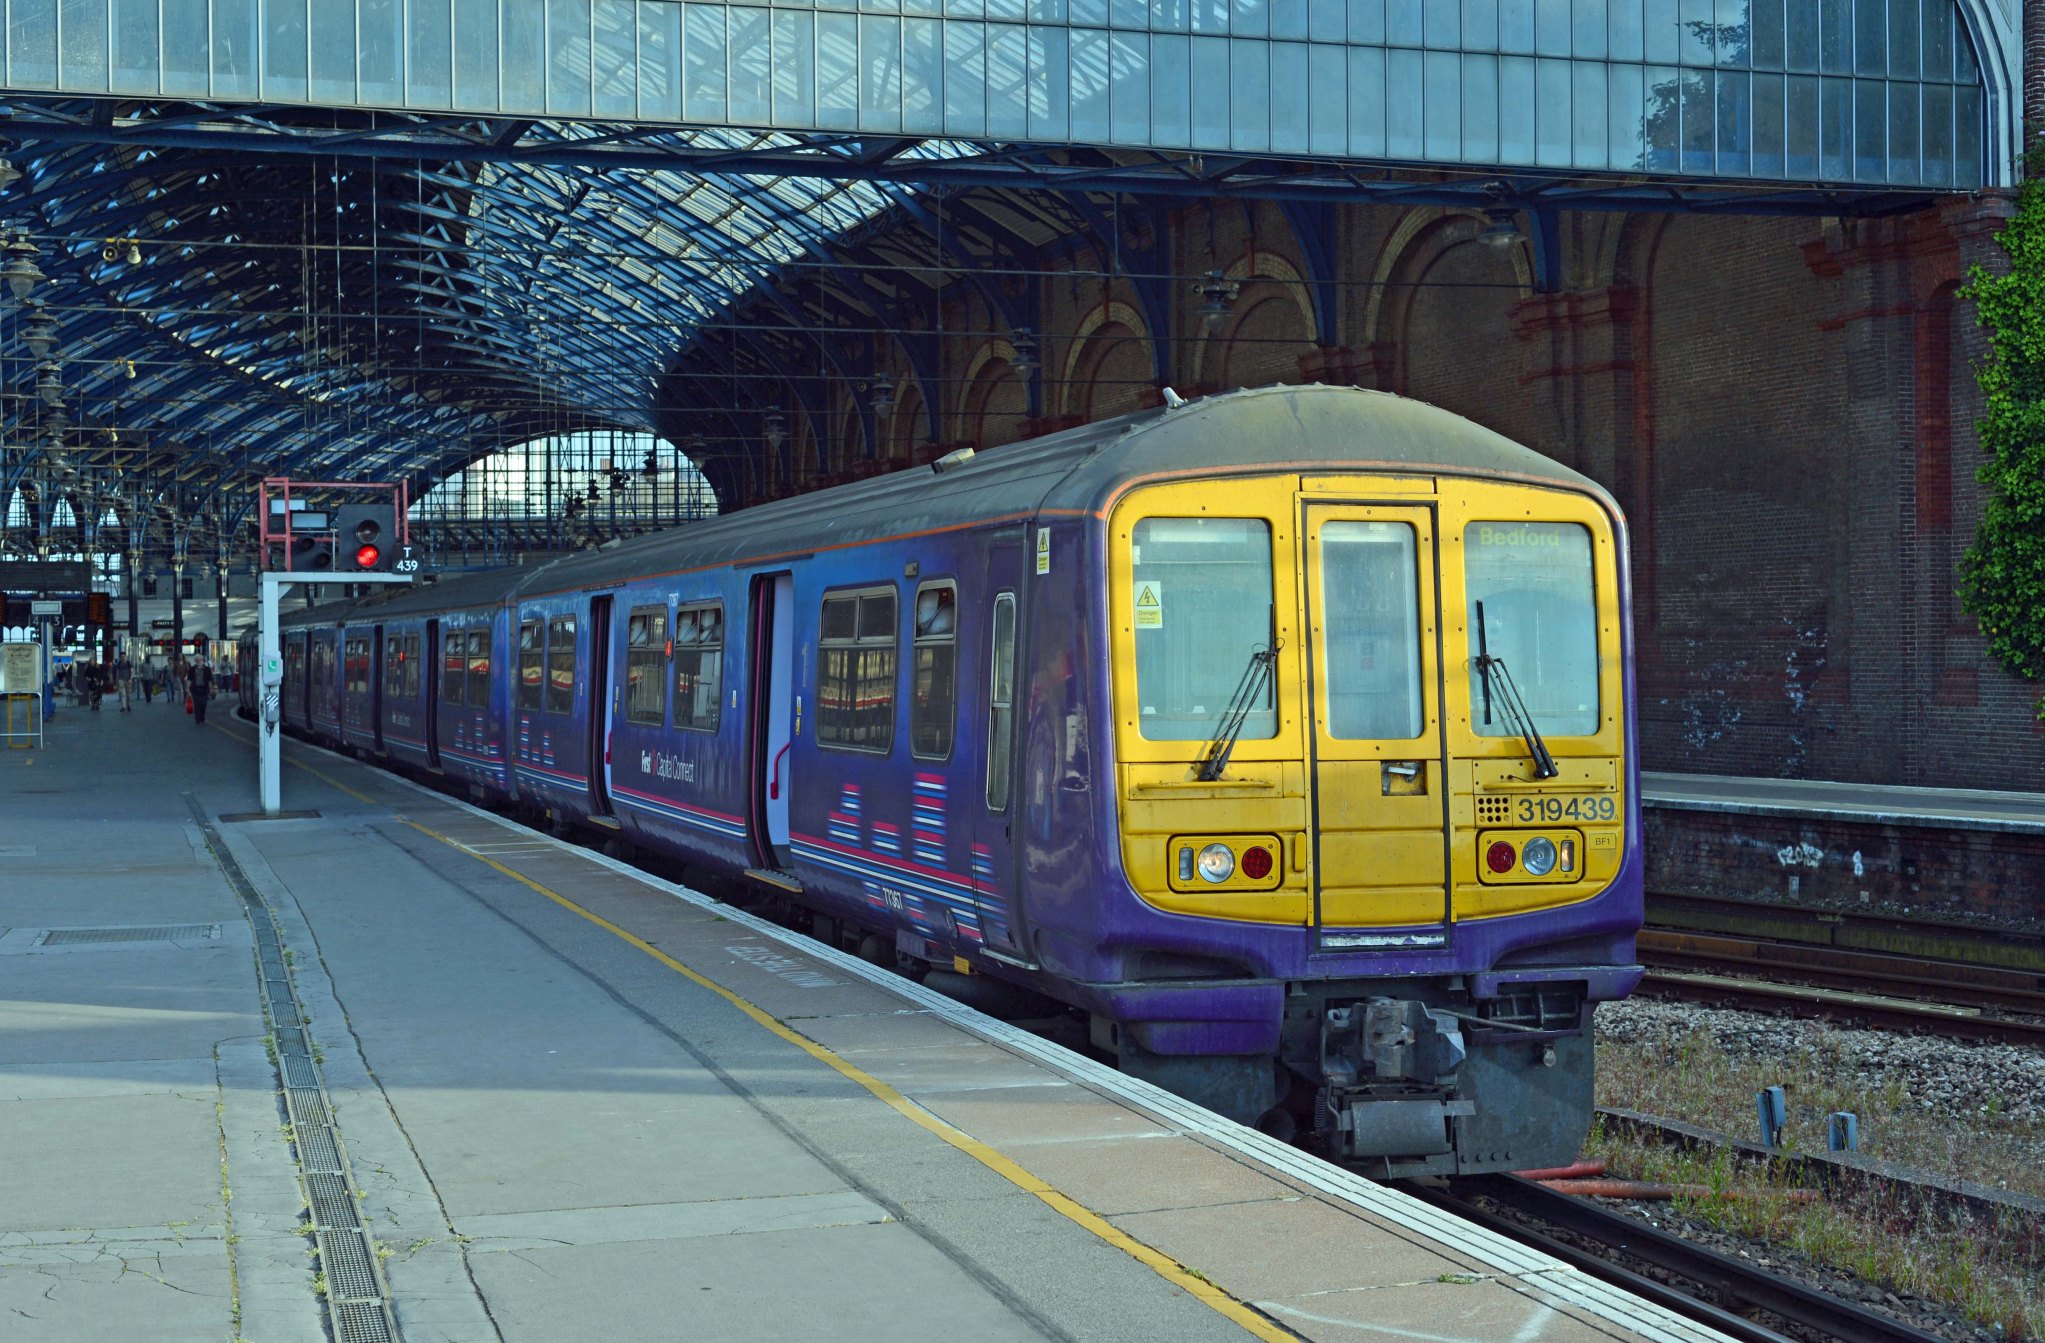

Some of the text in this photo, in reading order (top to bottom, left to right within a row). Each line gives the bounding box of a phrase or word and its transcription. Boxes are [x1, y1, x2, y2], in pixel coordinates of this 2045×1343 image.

[1480, 526, 1559, 546] Bedford
[403, 547, 412, 558] T
[396, 560, 418, 572] 439
[33, 616, 39, 625] 4
[53, 616, 60, 626] 3
[656, 752, 673, 783] Capital
[672, 755, 694, 783] Connect
[1518, 797, 1615, 822] 319439
[1595, 837, 1610, 845] BF1
[882, 887, 904, 910] 77367
